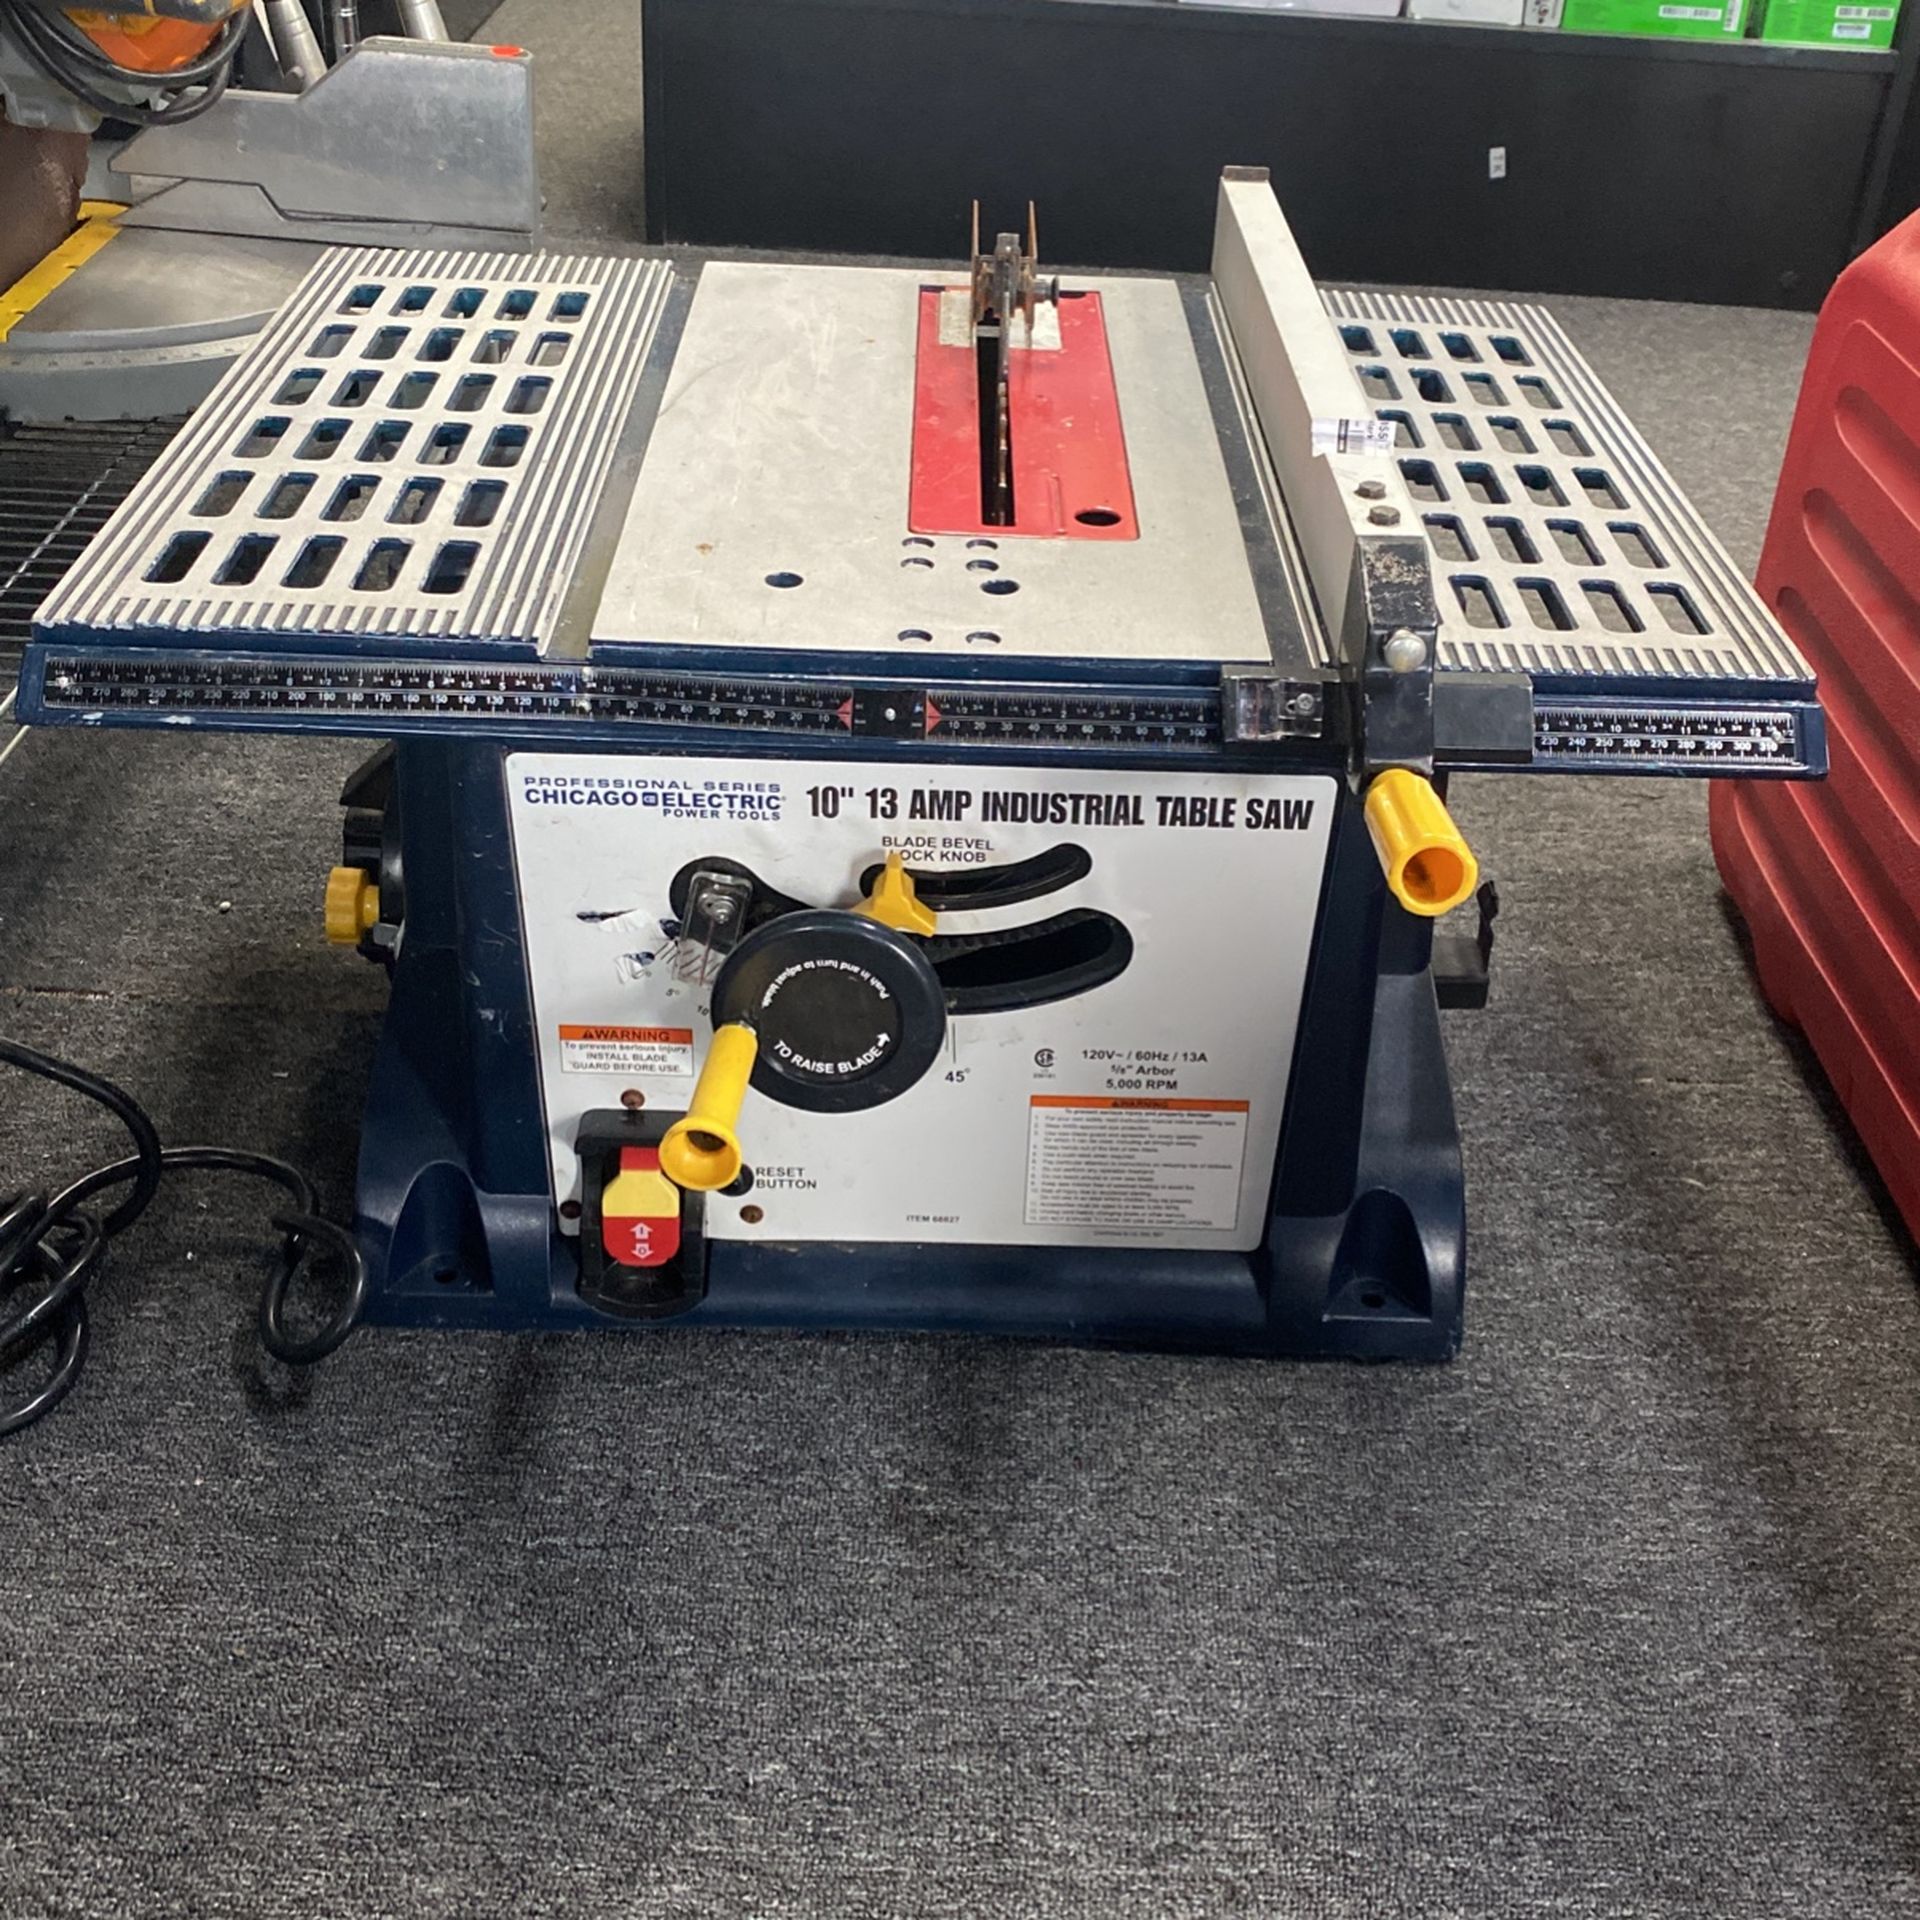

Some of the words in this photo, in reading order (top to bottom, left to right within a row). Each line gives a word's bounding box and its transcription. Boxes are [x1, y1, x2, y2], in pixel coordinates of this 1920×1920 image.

[232, 690, 250, 699] 220
[260, 691, 278, 700] 210
[288, 691, 306, 700] 200
[374, 693, 392, 702] 170
[430, 694, 448, 703] 150
[458, 695, 476, 704] 140
[486, 695, 504, 705] 130
[514, 696, 532, 706] 120
[542, 697, 560, 706] 110
[680, 705, 693, 714] 60
[708, 707, 722, 716] 50
[736, 708, 749, 717] 40
[790, 712, 803, 721] 20
[818, 714, 830, 723] 10
[974, 721, 986, 730] 20
[1001, 722, 1014, 731] 30
[1028, 723, 1041, 732] 40
[1055, 724, 1068, 733] 50
[1081, 725, 1094, 734] 60
[1610, 725, 1622, 733] 10
[1568, 738, 1586, 746] 240
[1595, 738, 1614, 747] 250
[1650, 740, 1669, 748] 270
[524, 777, 693, 790] PROFESSIONAL
[703, 781, 781, 793] SERIES
[525, 788, 638, 807] CHICAGO
[662, 792, 781, 810] ELECTRIC
[806, 786, 854, 819] 10"
[865, 788, 898, 819] 13
[909, 789, 972, 821] AMP
[981, 791, 1144, 829] INDUSTRIAL
[1156, 796, 1237, 829] TABLE
[1245, 798, 1314, 830] SAW
[663, 808, 720, 819] POWER
[727, 810, 781, 821] TOOLS
[882, 836, 937, 848] BLADE
[942, 837, 995, 851] BEVEL
[940, 851, 987, 863] KNOB
[803, 960, 815, 969] to
[815, 959, 838, 969] turn
[839, 961, 860, 974] and
[594, 1029, 670, 1042] WARNING
[579, 1042, 617, 1051] prevent
[586, 1052, 629, 1061] INSTALL
[632, 1053, 668, 1063] BLADE
[773, 1040, 793, 1058] TO
[790, 1054, 835, 1074] RAISE
[837, 1045, 883, 1074] BLADE
[1135, 1051, 1169, 1062] 60Hz
[1182, 1052, 1208, 1062] 13A
[571, 1062, 611, 1071] GUARD
[613, 1063, 656, 1072] BEFORE
[1135, 1065, 1175, 1076] Arbor
[1106, 1079, 1142, 1090] 5,000
[1145, 1080, 1177, 1090] RPM
[756, 1167, 805, 1177] RESET
[756, 1179, 817, 1189] BUTTON
